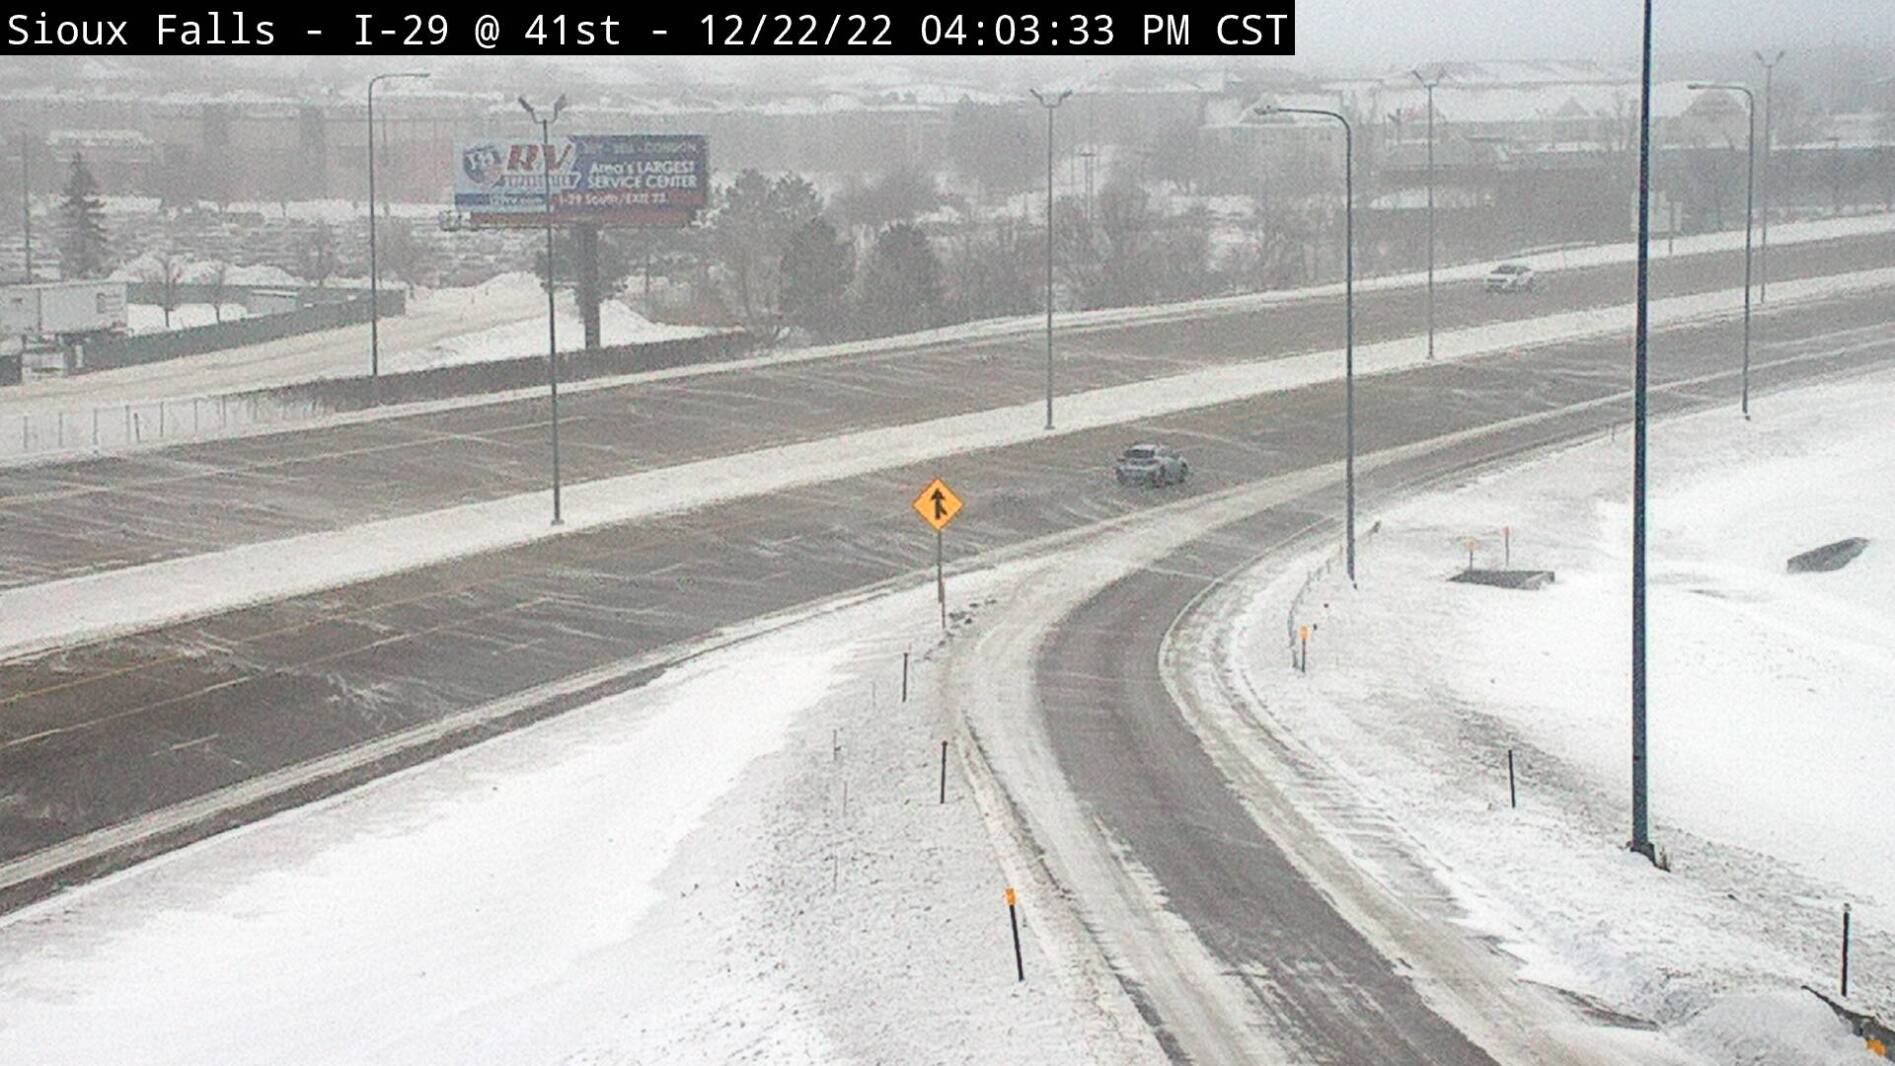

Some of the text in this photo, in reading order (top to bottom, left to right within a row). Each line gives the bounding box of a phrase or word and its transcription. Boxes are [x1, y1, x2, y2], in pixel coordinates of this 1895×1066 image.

[506, 143, 574, 171] RV
[589, 161, 695, 175] Area's LARGEST
[588, 175, 642, 189] SERVICE
[646, 175, 697, 188] CENTER
